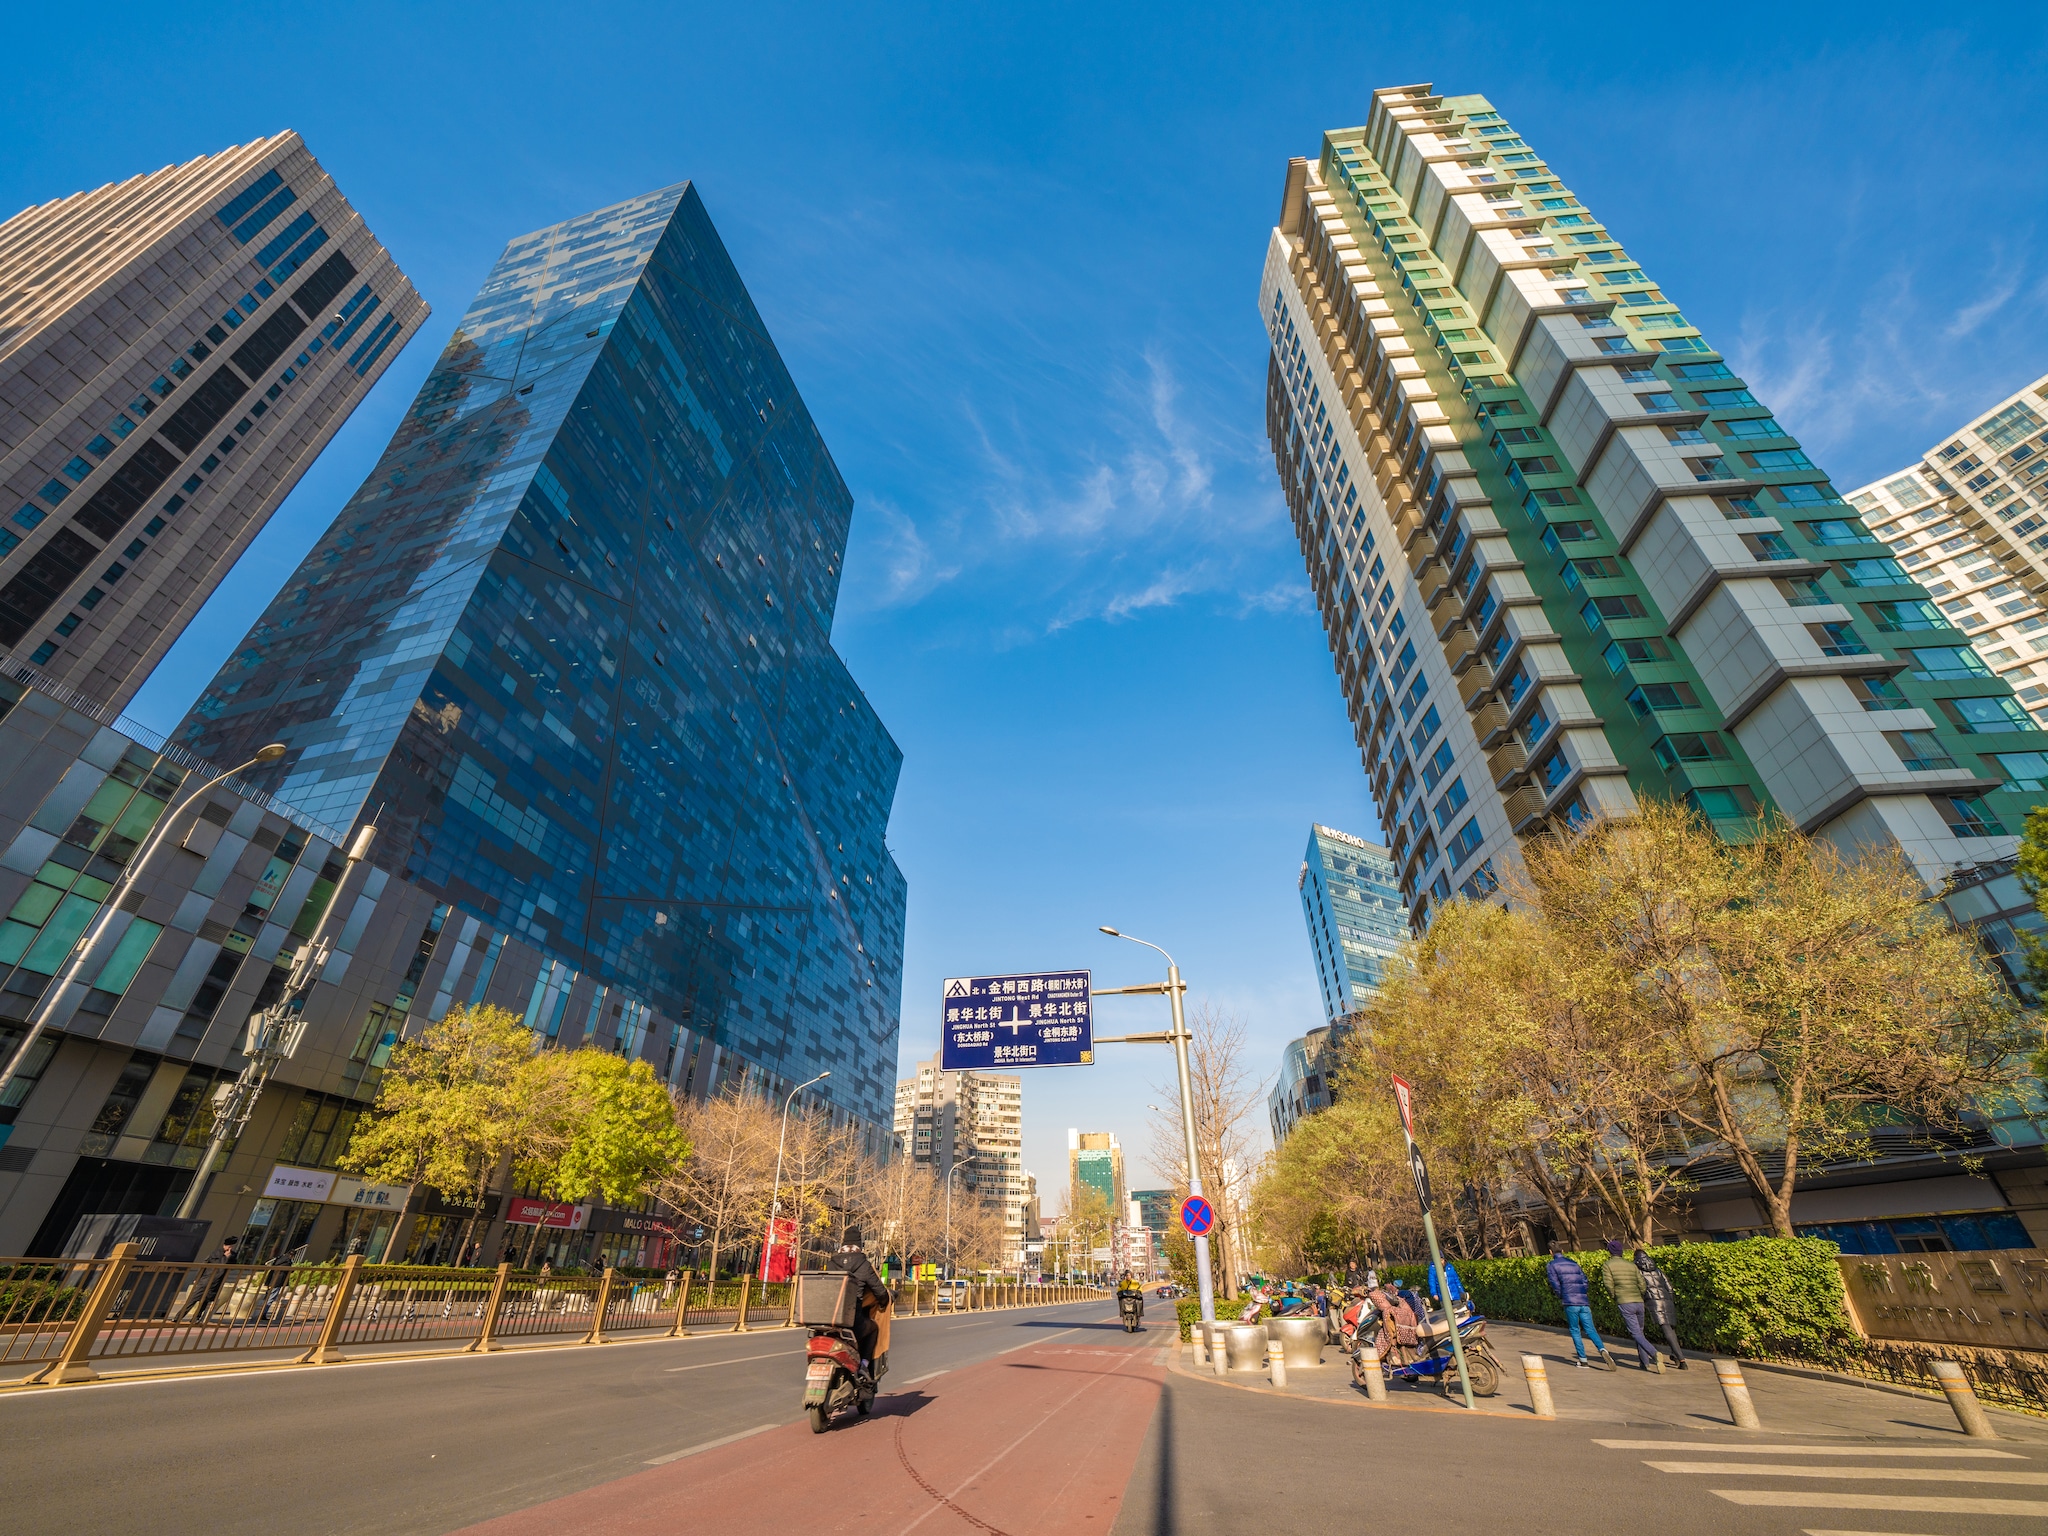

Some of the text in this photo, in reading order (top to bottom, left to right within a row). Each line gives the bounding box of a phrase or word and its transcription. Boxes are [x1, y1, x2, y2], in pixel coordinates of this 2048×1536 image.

[972, 987, 979, 995] 北
[988, 979, 1044, 995] 金桐西路
[946, 1006, 1003, 1022] 景华北街
[1028, 1001, 1087, 1018] 景华北街
[1035, 1018, 1059, 1026] JINGHUA
[953, 1030, 994, 1043] (东大桥路)
[1038, 1025, 1082, 1038] (金桐东路)
[993, 1045, 1037, 1058] 景华北街口
[1875, 1304, 1992, 1326] CENTRAL
